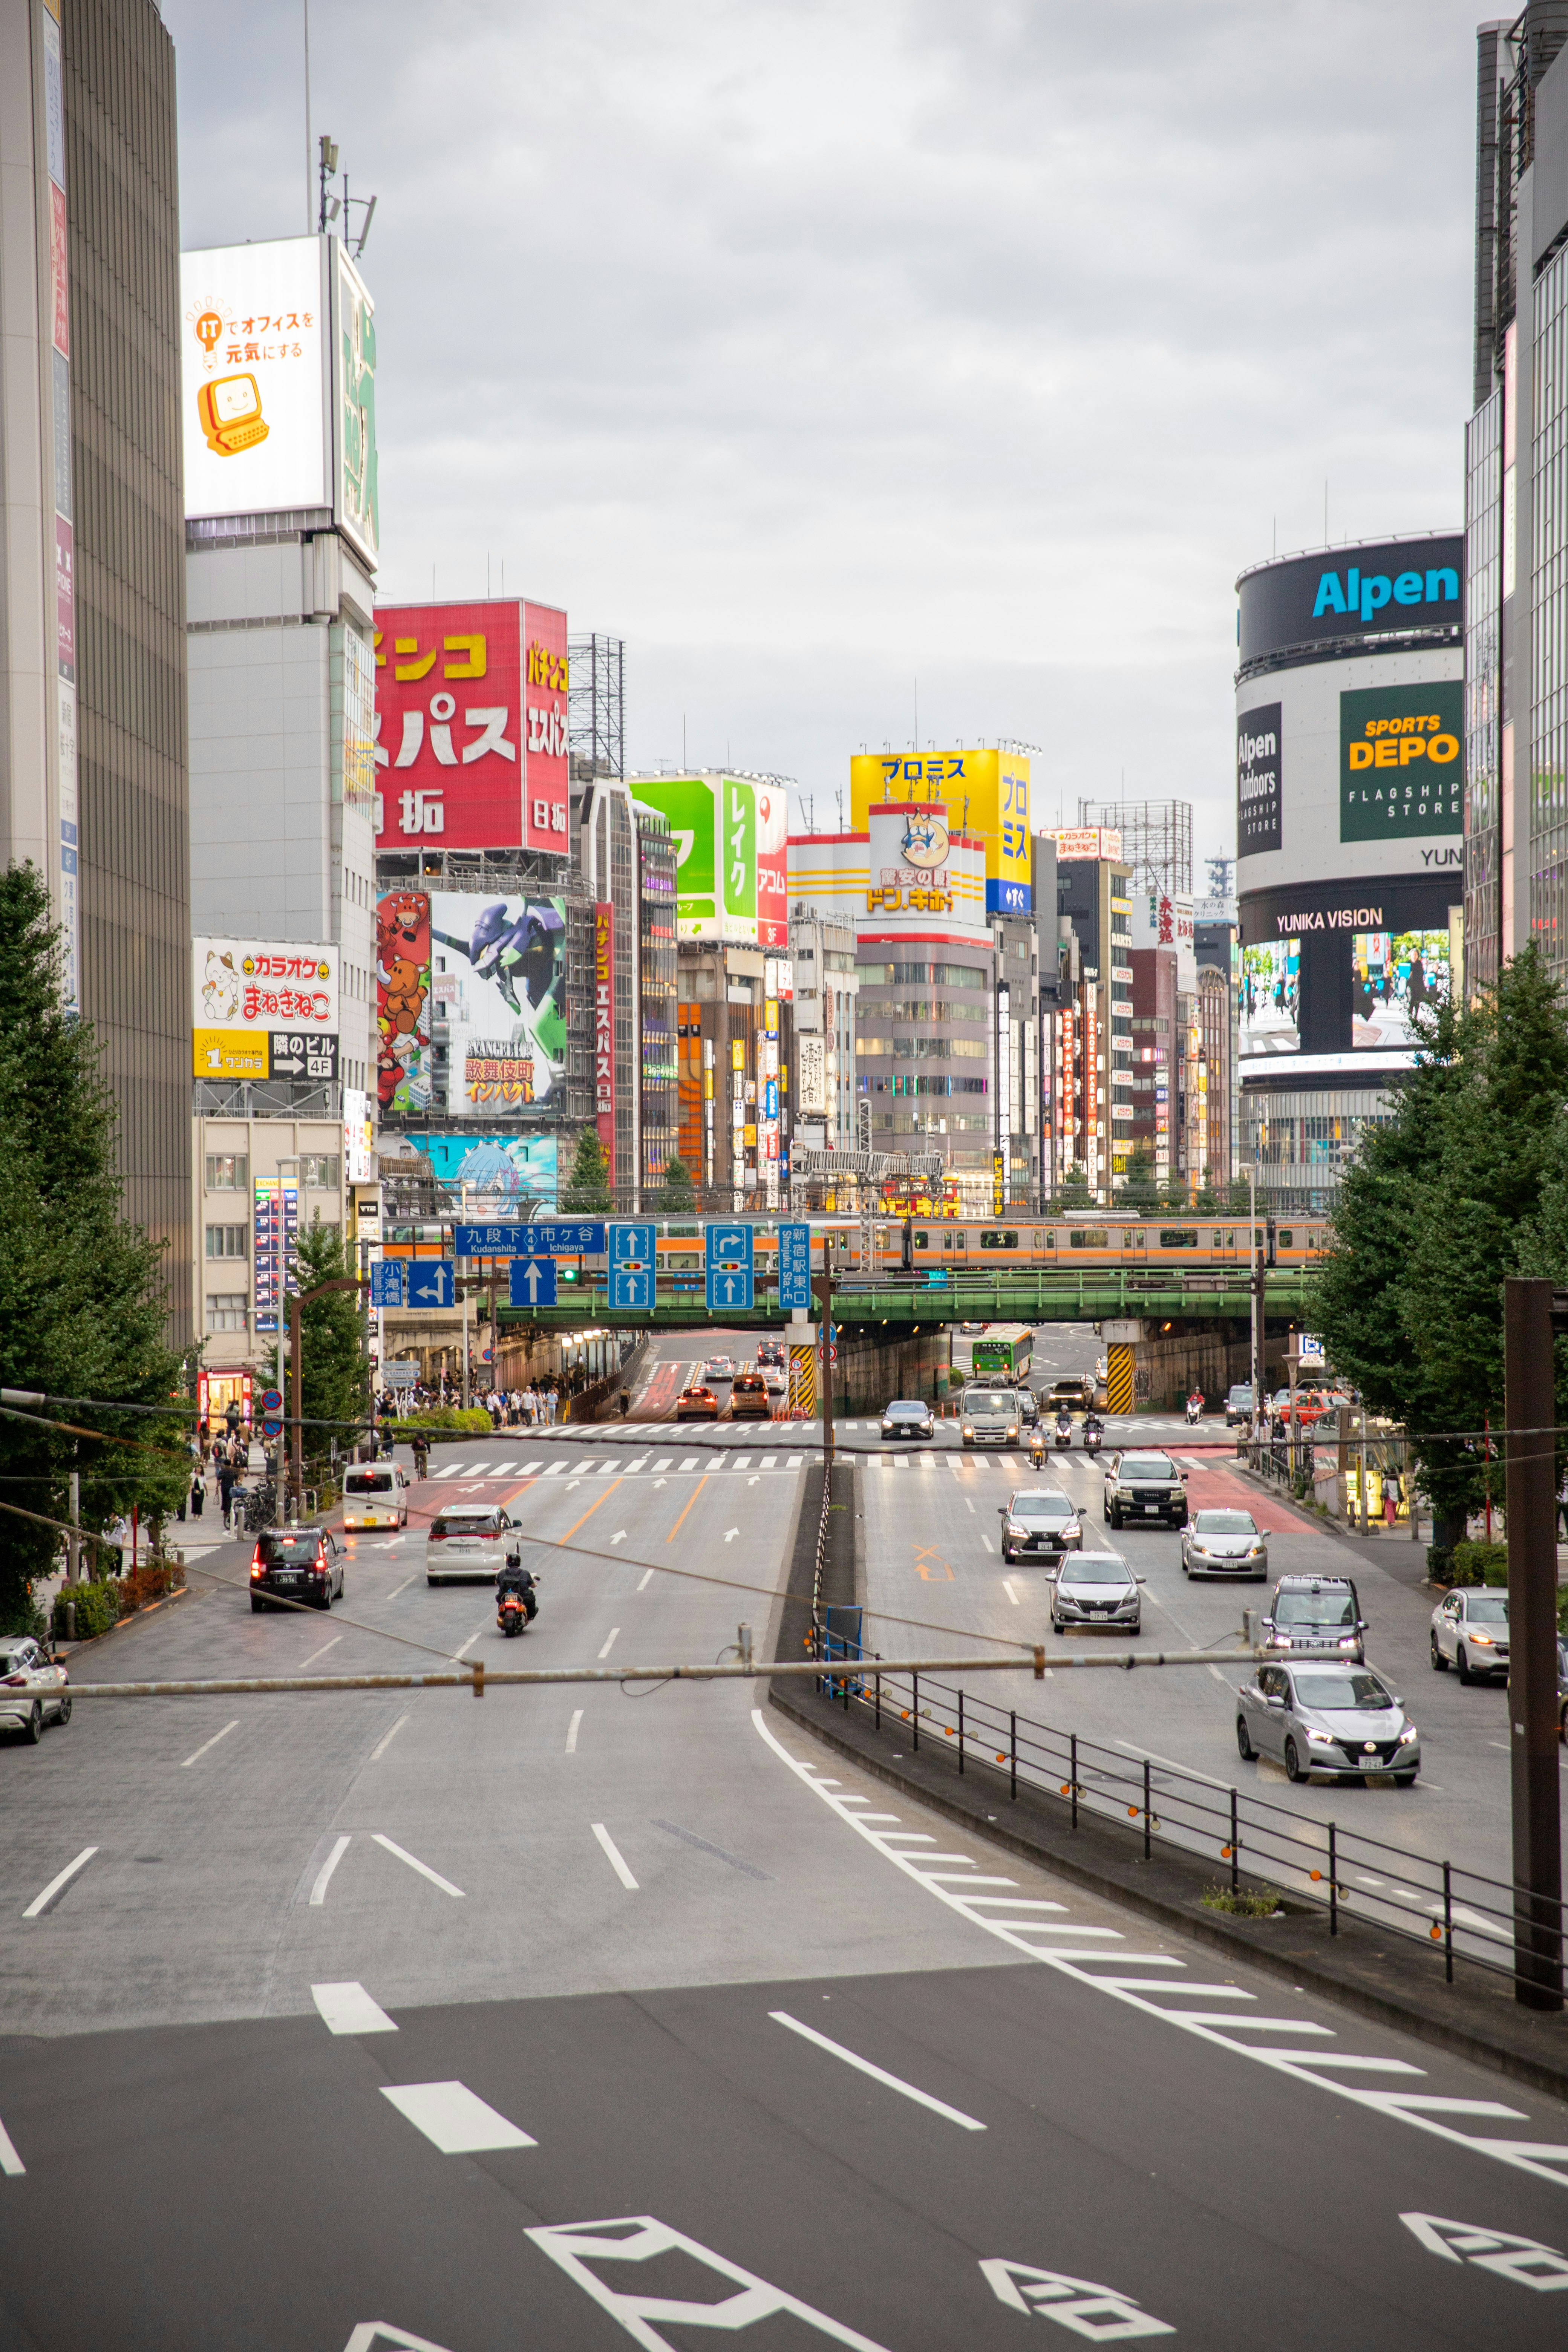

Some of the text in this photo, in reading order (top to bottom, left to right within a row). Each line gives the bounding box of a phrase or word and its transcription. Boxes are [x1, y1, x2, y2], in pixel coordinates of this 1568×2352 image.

[226, 342, 302, 364] 元気にする
[1312, 565, 1459, 622] Alpen
[528, 640, 568, 692] パチンコ
[528, 700, 569, 758] エスパス
[1364, 714, 1440, 738] SPORTS
[1238, 730, 1276, 766] Alpen
[1349, 733, 1460, 770] DEPO
[881, 758, 967, 780] プロミス
[1002, 771, 1027, 816] プロ
[1240, 768, 1276, 802] Outdoors
[1349, 782, 1459, 803] FLAGSHIP
[534, 798, 567, 833] 日拓
[1238, 801, 1277, 821] FLAGSHIP
[1388, 801, 1459, 817] STORE
[1247, 818, 1277, 835] STORE
[730, 787, 746, 897] レイク
[1002, 820, 1028, 861] ミス
[1060, 842, 1096, 854] まねきねこ
[646, 877, 673, 892] SHISHA
[758, 868, 786, 895] アコム
[1010, 887, 1024, 907] すぐ
[1201, 900, 1224, 909] 水の森
[1277, 907, 1383, 933] YUNIKA VISION
[651, 925, 673, 939] POKER
[767, 927, 777, 943] 3F
[1111, 933, 1132, 948] DARTS
[596, 912, 609, 980] パチンコ
[254, 954, 317, 979] カラオケ
[243, 983, 330, 1020] まねきねこ
[273, 1034, 335, 1056] 隣のビル
[467, 1040, 534, 1058] EVANGELION
[225, 1057, 263, 1069] ワンカラ
[310, 1060, 329, 1073] 4F
[466, 1059, 534, 1081] 歌舞伎町
[465, 1081, 535, 1102] インパクト
[467, 1227, 522, 1243] 九段下
[528, 1236, 534, 1244] 4
[471, 1243, 584, 1253] Kudanshita Ichigaya
[782, 1230, 792, 1268] Shinjuku
[792, 1228, 806, 1304] 新宿駅東口
[384, 1264, 400, 1304] 小滝橋
[372, 1291, 384, 1305] Brdg.
